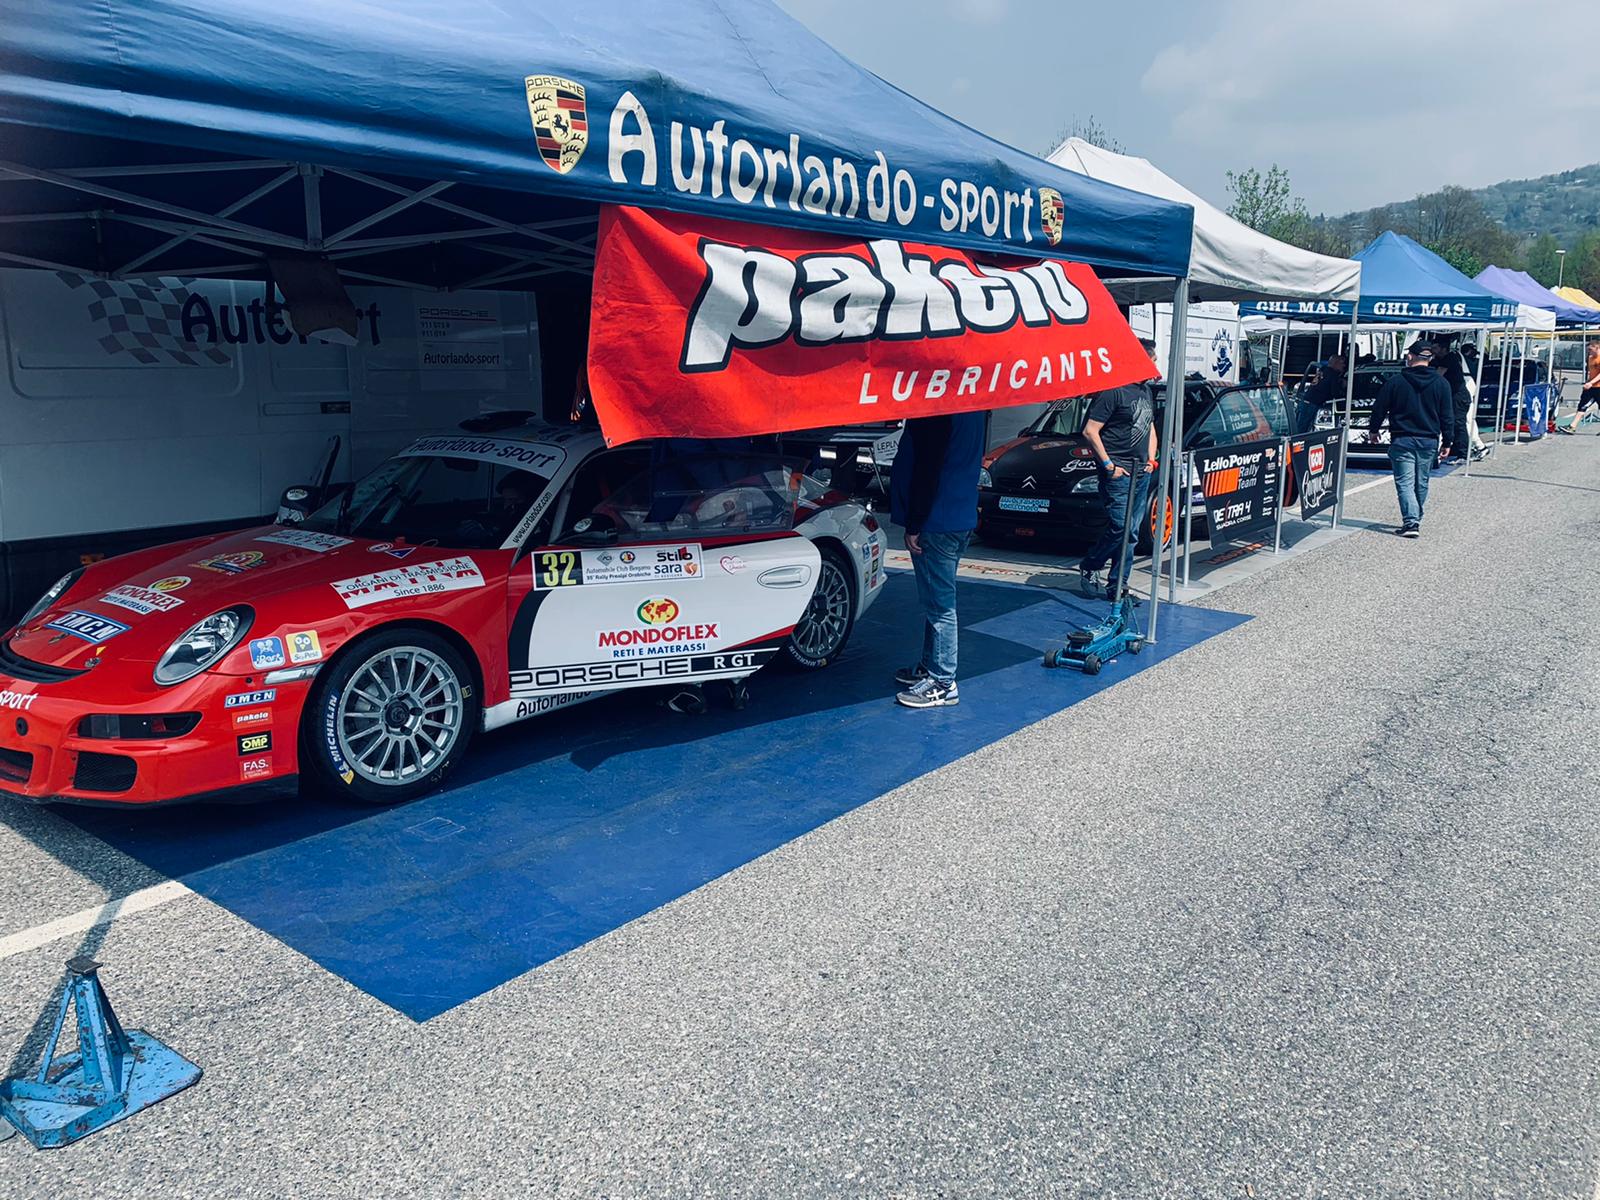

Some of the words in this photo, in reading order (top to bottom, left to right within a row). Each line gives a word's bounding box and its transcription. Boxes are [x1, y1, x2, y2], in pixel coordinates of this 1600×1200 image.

[526, 77, 584, 96] PORSCHE
[1298, 302, 1344, 315] MAS.
[1373, 302, 1413, 316] GHI.
[1420, 303, 1472, 317] MAS.
[424, 352, 500, 365] Autorlando-sport
[859, 346, 1114, 405] LUBRICANTS
[408, 437, 556, 468] Autorlando-sport
[1239, 464, 1260, 478] Rally
[1238, 478, 1257, 490] Team
[656, 547, 693, 562] Stilo
[346, 577, 388, 590] ORGANI
[402, 562, 471, 579] TRASMISSIONE
[542, 552, 577, 587] 32
[654, 563, 682, 574] sara
[393, 586, 420, 597] Since
[423, 583, 445, 592] 1886
[54, 613, 119, 639] OMCN
[598, 623, 718, 648] MONDOFLEX
[613, 648, 637, 657] RETI
[639, 647, 645, 656] E
[647, 642, 706, 656] MATERASSI
[510, 657, 690, 689] PORSCHE
[713, 656, 725, 669] R
[731, 654, 754, 667] GT
[228, 691, 273, 705] OMCN
[236, 711, 269, 723] pakelo
[326, 695, 342, 763] MICHELIN
[242, 737, 268, 749] OMP
